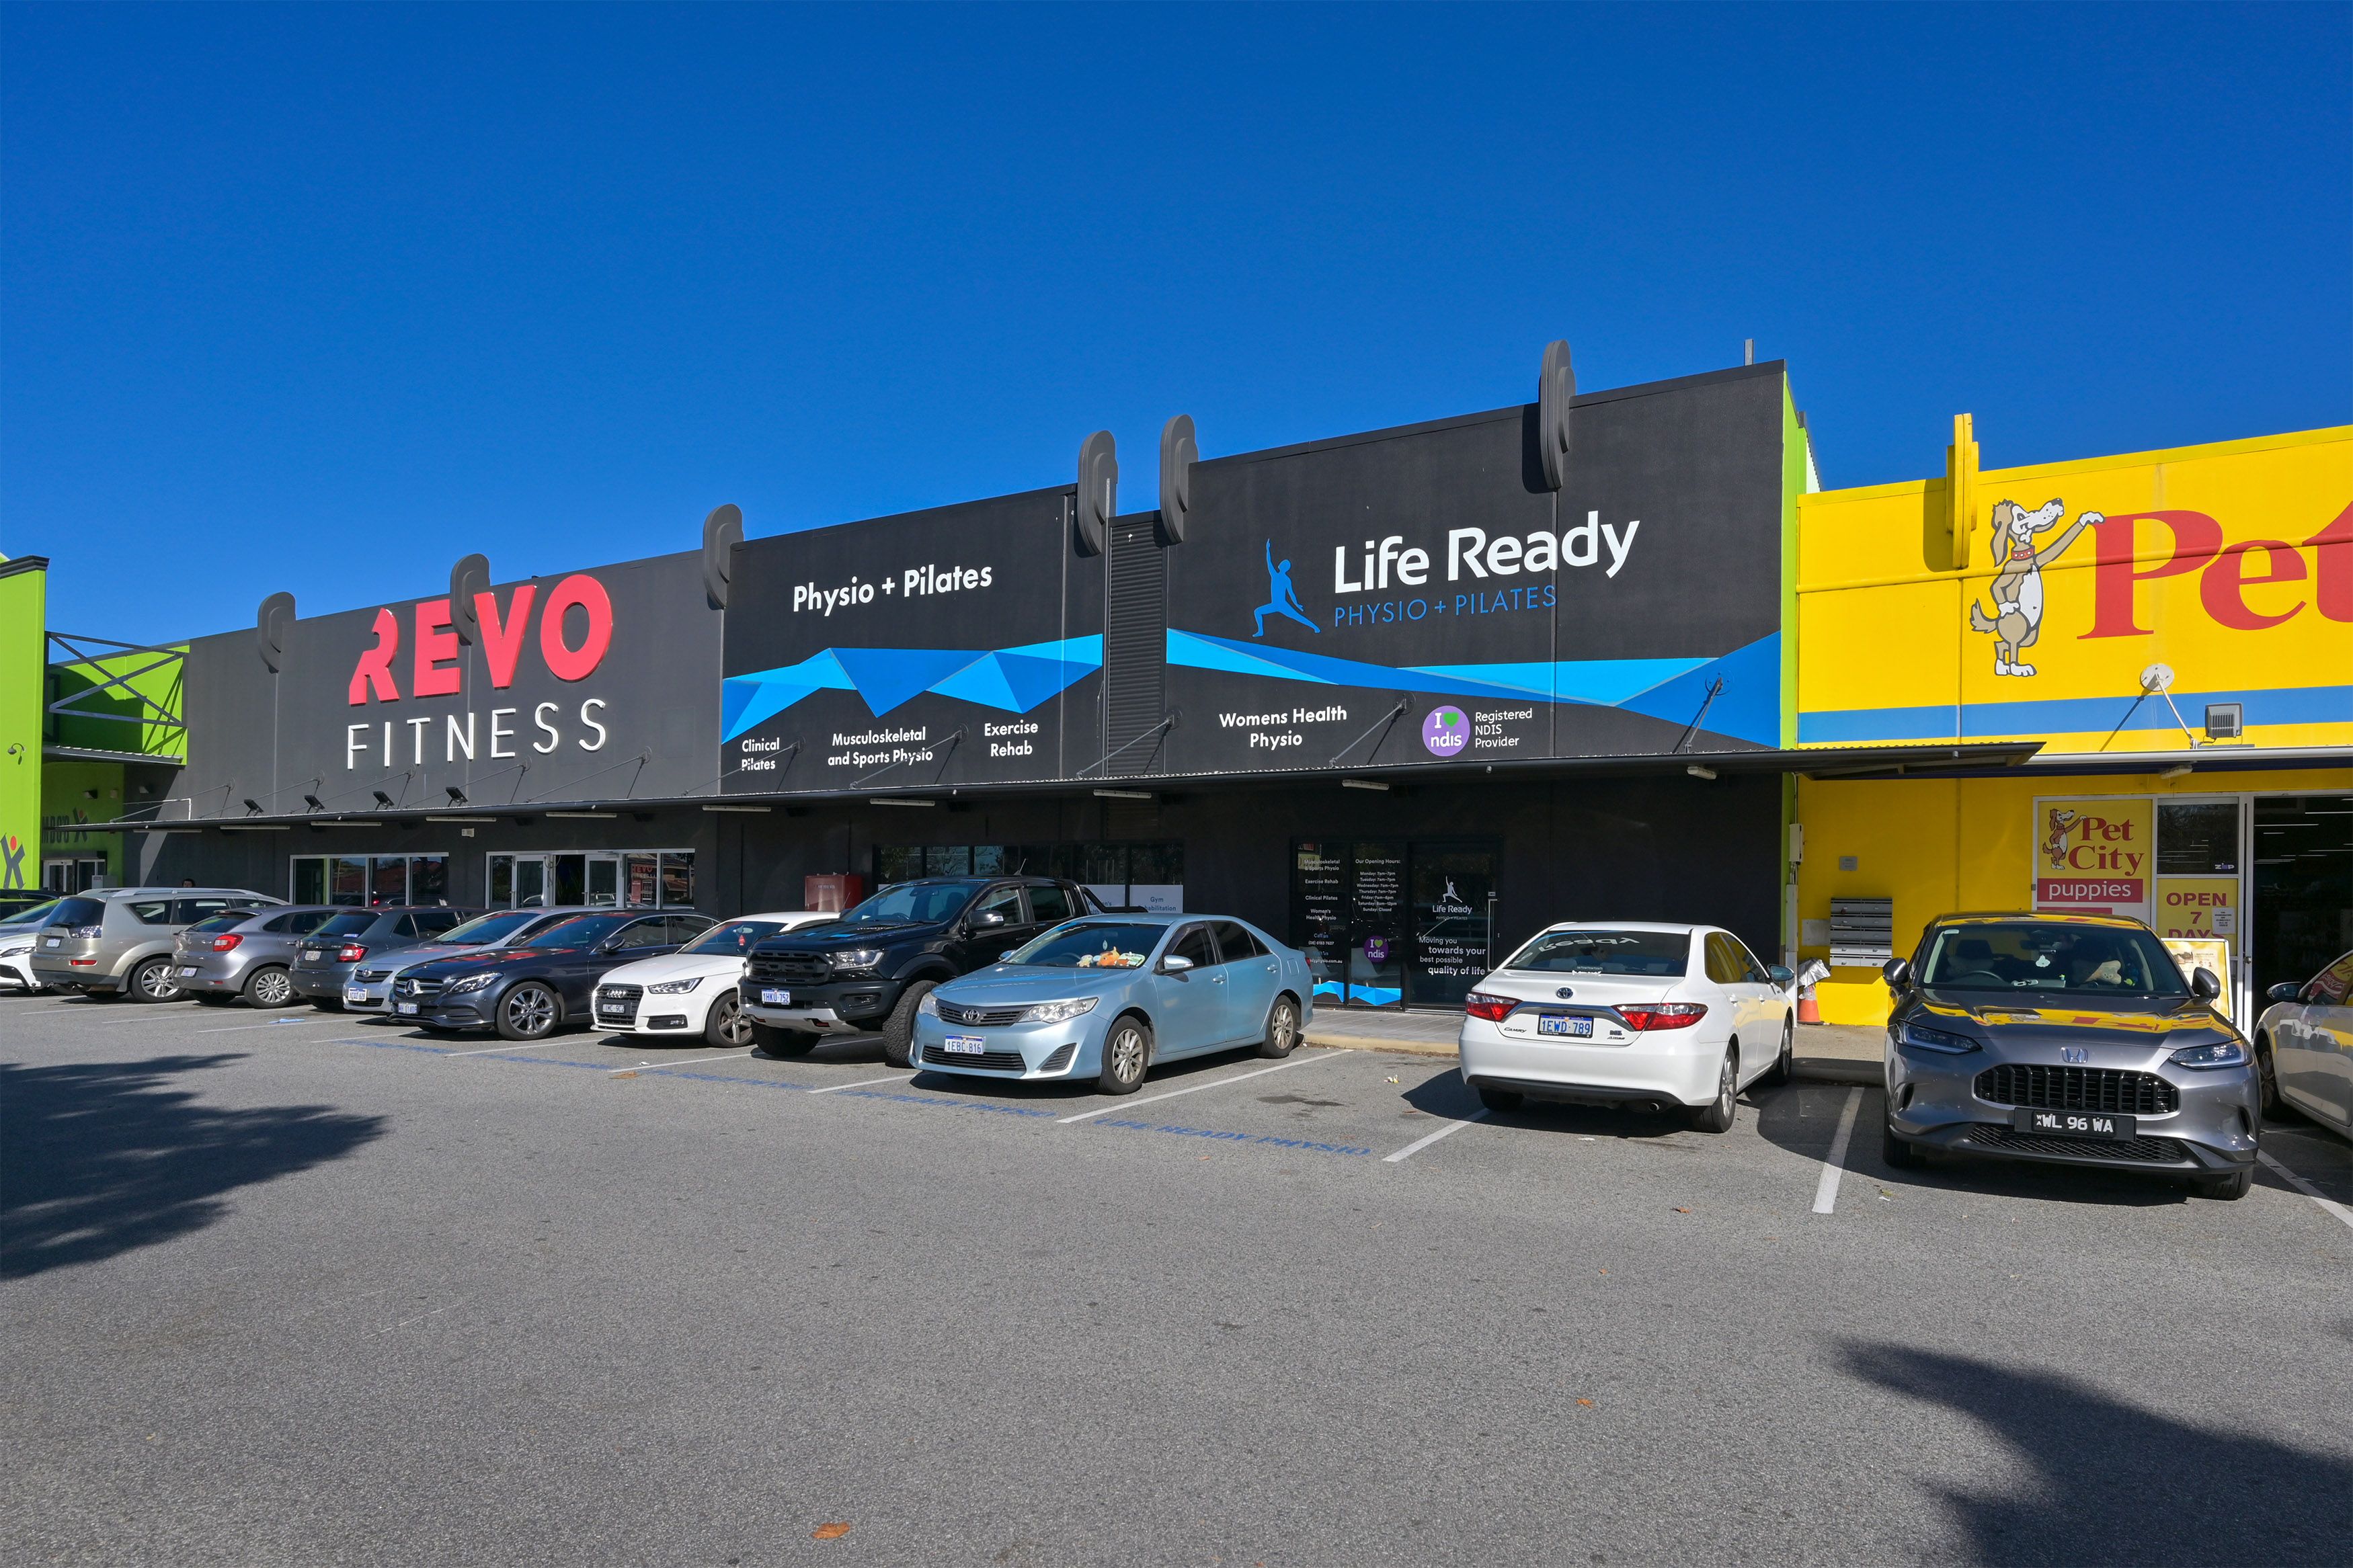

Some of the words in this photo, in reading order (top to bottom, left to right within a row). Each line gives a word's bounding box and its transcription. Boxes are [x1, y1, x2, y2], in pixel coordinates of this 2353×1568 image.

[1335, 535, 1430, 593] Life
[1448, 510, 1640, 581] Ready
[793, 576, 875, 617] Physio
[881, 577, 895, 595] +
[904, 564, 992, 597] Pilates
[1334, 599, 1427, 627] PHYSIO
[1434, 600, 1446, 613] +
[1455, 585, 1556, 616] PILATES
[349, 574, 612, 705] REVO
[1219, 712, 1288, 728] Womens
[1293, 706, 1347, 723] Health
[1475, 708, 1533, 724] Registered
[348, 699, 606, 770] FITNESS
[832, 727, 926, 746] Musculoskeletal
[984, 719, 1039, 737] Exercise
[1475, 724, 1502, 735] NDIS
[742, 737, 780, 752] Clinical
[1250, 730, 1302, 751] Physio
[1431, 731, 1462, 747] ndis
[1475, 737, 1519, 748] Provider
[990, 740, 1033, 757] Rehab
[741, 758, 776, 771] Pilates
[828, 751, 850, 766] and
[852, 749, 889, 768] Sports
[893, 747, 933, 766] Physio
[2080, 817, 2134, 841] Pet
[2069, 845, 2145, 876] City
[2049, 880, 2131, 900] puppies
[2166, 893, 2227, 906] OPEN
[1432, 905, 1446, 913] Life
[1447, 905, 1472, 915] Ready
[2190, 911, 2202, 924] 7
[1419, 936, 1443, 945] Moving
[2168, 929, 2224, 938] DAY
[1368, 949, 1384, 958] ndis
[1428, 946, 1464, 954] towards
[1466, 948, 1486, 956] your
[1428, 966, 1458, 976] quality
[1460, 966, 1470, 975] of
[1472, 966, 1485, 975] life
[2042, 1114, 2062, 1129] WL
[2067, 1117, 2087, 1130] 96
[2093, 1118, 2114, 1132] WA
